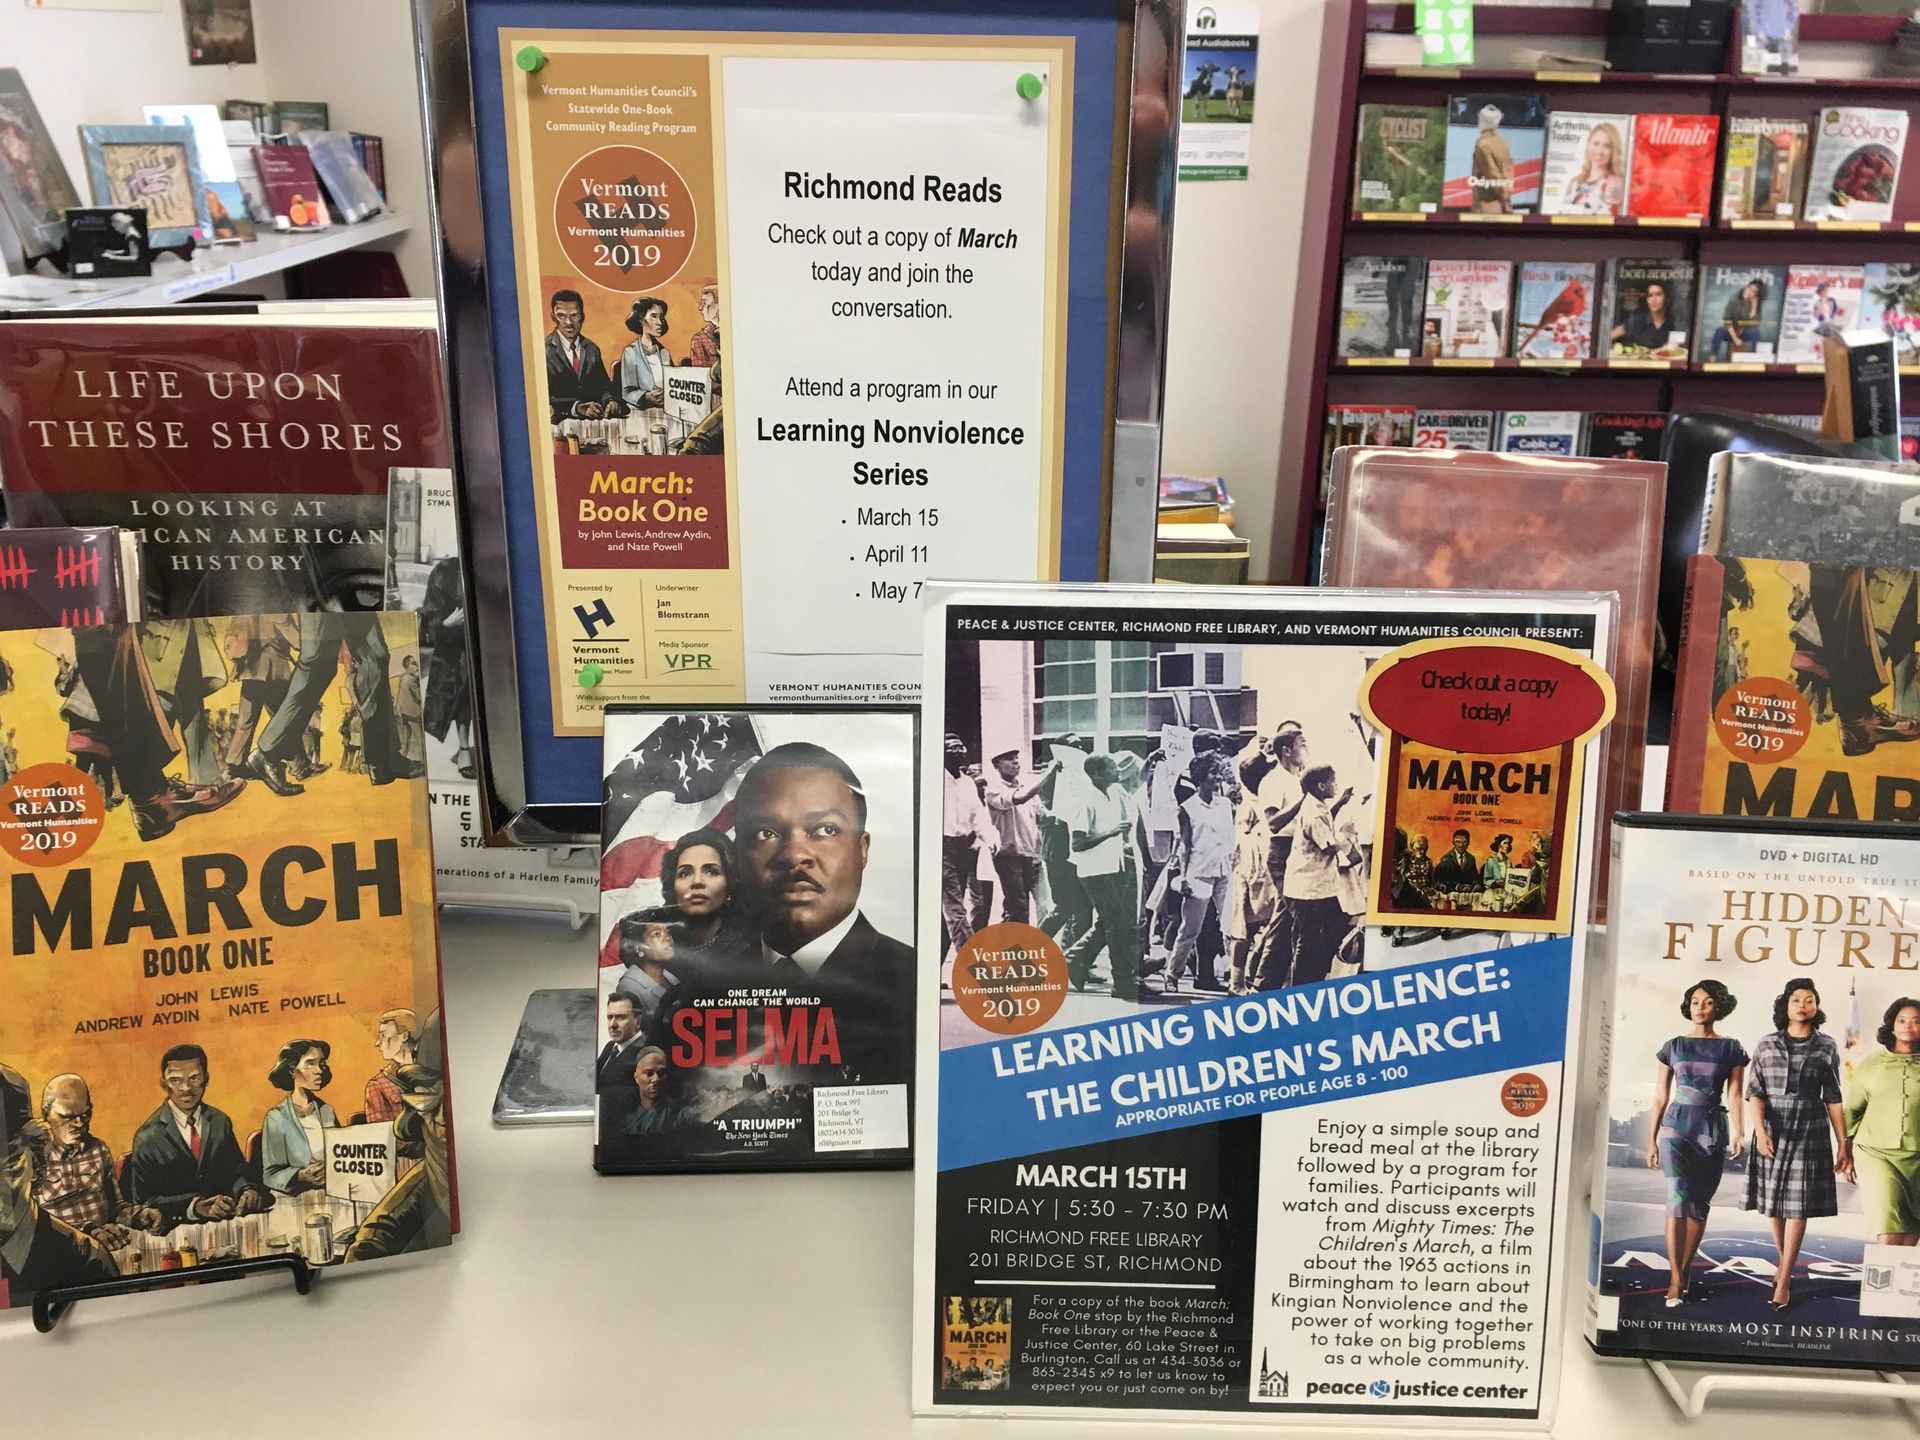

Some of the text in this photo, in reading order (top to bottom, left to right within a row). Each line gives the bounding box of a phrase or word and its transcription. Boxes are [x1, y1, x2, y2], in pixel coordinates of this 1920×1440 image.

[542, 85, 696, 97] Vermont Humanities Council's
[568, 103, 672, 114] Statewide One-Book
[546, 121, 696, 135] Community Reading Program
[1380, 118, 1428, 138] CYCLIST
[1649, 120, 1715, 146] Atlantic
[1824, 124, 1899, 144] Cooking
[580, 179, 668, 197] Vermont
[784, 172, 1001, 202] Richmond Reads
[584, 203, 670, 219] READS
[568, 226, 685, 237] Vermont Humanities
[768, 223, 1018, 251] Check out a copy of March
[594, 245, 661, 266] 2019
[1716, 268, 1773, 286] Health
[74, 371, 342, 401] LIFE UPON
[669, 378, 706, 395] COUNTER
[669, 390, 703, 405] CLOSED
[1417, 415, 1440, 427] CAR
[1449, 416, 1488, 428] DRIVER
[1508, 415, 1526, 428] CR
[29, 421, 402, 452] THESE SHORES
[757, 418, 1024, 448] Learning Nonviolence
[590, 471, 693, 494] March:
[853, 462, 928, 486] Series
[132, 500, 326, 517] LOOKING AT
[579, 500, 708, 522] Book One
[857, 508, 939, 526] March 15
[228, 529, 384, 545] AMERICAN
[608, 542, 683, 551] and Nate Powell
[172, 555, 303, 571] HISTORY
[865, 545, 927, 567] April 11
[657, 600, 671, 608] Jan
[658, 611, 709, 619] Blomstrann
[957, 619, 1583, 638] PEACE & JUSTICE CENTER, RICHMOND FREE LIBRARY, AND VERMONT HUMANITIES COUNCIL PRESENT:
[665, 654, 712, 668] VPR
[1422, 671, 1558, 697] Check out a copy
[769, 694, 868, 702] vermonthumanities.org
[1461, 702, 1511, 725] today!
[1408, 758, 1552, 794] MARCH
[13, 784, 85, 798] Vermont
[442, 794, 470, 806] THE
[1453, 792, 1500, 806] BOOK ONE
[15, 800, 86, 815] READS
[21, 831, 77, 851] 2019
[1760, 850, 1879, 865] DVD DIGITAL HD
[520, 872, 599, 886] Harlem Family
[11, 838, 402, 956] MARCH
[1722, 890, 1909, 928] HIDDEN
[144, 936, 274, 978] BOOK ONE
[718, 998, 759, 1006] CHANGE
[786, 997, 820, 1005] WORLD
[728, 989, 787, 997] ONE DREAM
[991, 960, 1511, 1078] LEARNING NONVIOLENCE:
[672, 1007, 842, 1068] SELMA
[1027, 1011, 1501, 1121] THE CHILDREN'S MARCH
[1115, 1066, 1408, 1128] APPROPRIATE FOR PEOPLE AGE 8 100
[831, 1109, 850, 1118] Bridge
[1318, 1119, 1540, 1141] Enjoy a simple soup and
[333, 1144, 387, 1159] COUNTER
[334, 1160, 383, 1176] CLOSED
[1016, 1164, 1186, 1190] MARCH 15TH
[990, 1229, 1203, 1248] RICHMOND FREE LIBRARY
[968, 1253, 1222, 1272] 201 BRIDGE ST, RICHMOND
[1271, 1293, 1528, 1313] Kingian Nonviolence and the
[1729, 1322, 1899, 1342] MOST INSPIRING
[1307, 1380, 1528, 1400] peace justice center
